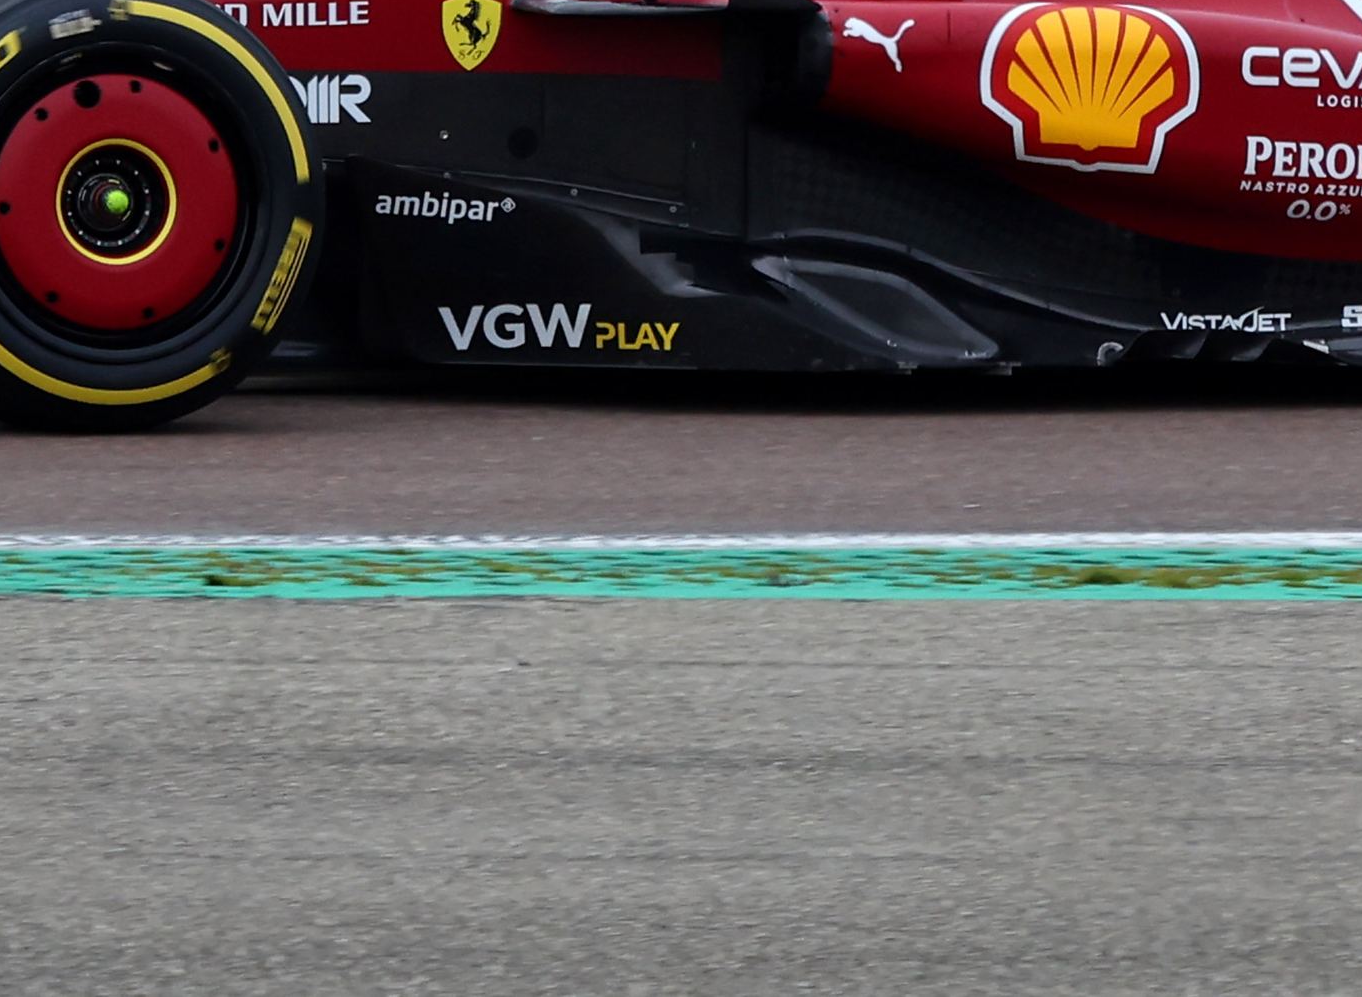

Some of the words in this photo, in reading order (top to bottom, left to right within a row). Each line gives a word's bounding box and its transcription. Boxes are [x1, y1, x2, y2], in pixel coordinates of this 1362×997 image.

[262, 0, 370, 27] MILLE
[1240, 180, 1310, 195] NASTRO
[374, 191, 499, 224] ambipar
[1286, 198, 1352, 222] 0.0%
[438, 303, 592, 351] VGW
[595, 322, 681, 351] PLAY
